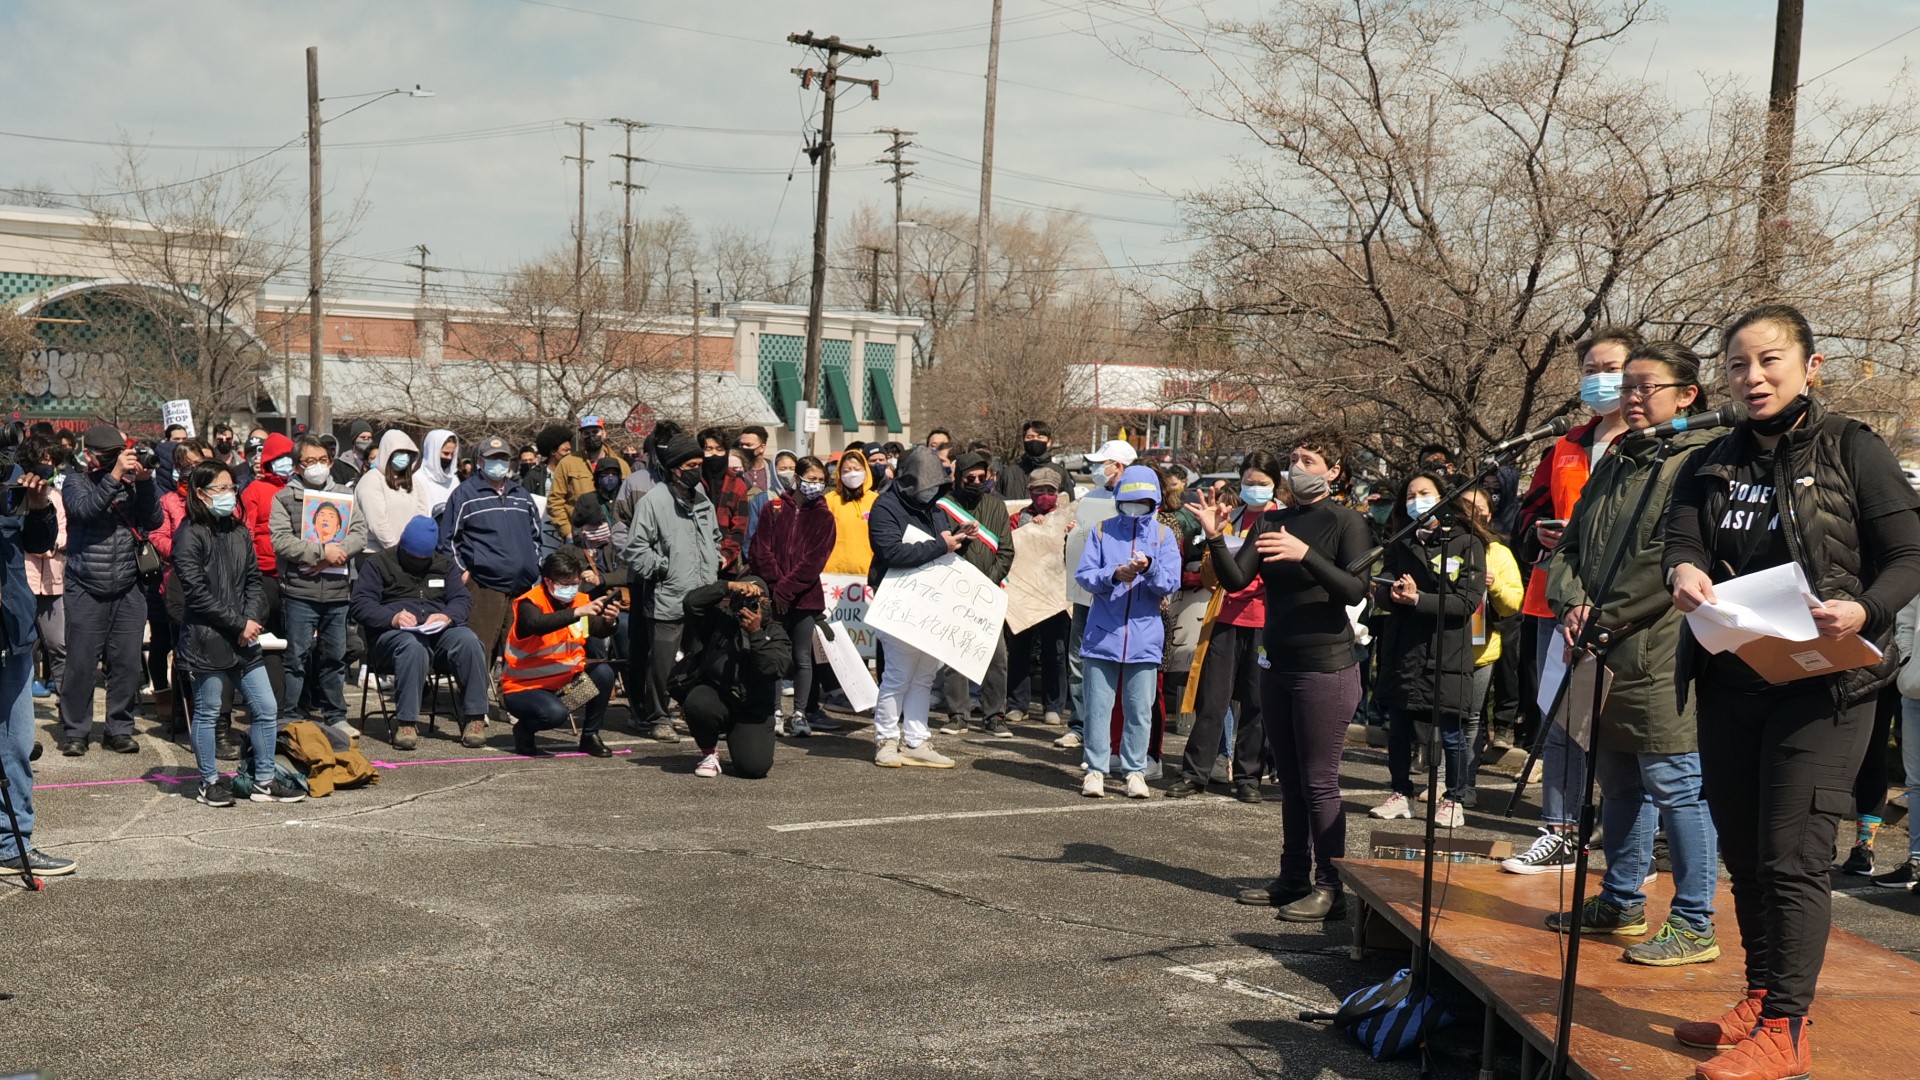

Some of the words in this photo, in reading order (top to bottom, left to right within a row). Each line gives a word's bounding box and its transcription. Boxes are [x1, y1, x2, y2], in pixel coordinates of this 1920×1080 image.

[1720, 510, 1780, 531] ASIN
[828, 607, 862, 622] YOUR
[952, 604, 994, 637] CRIME
